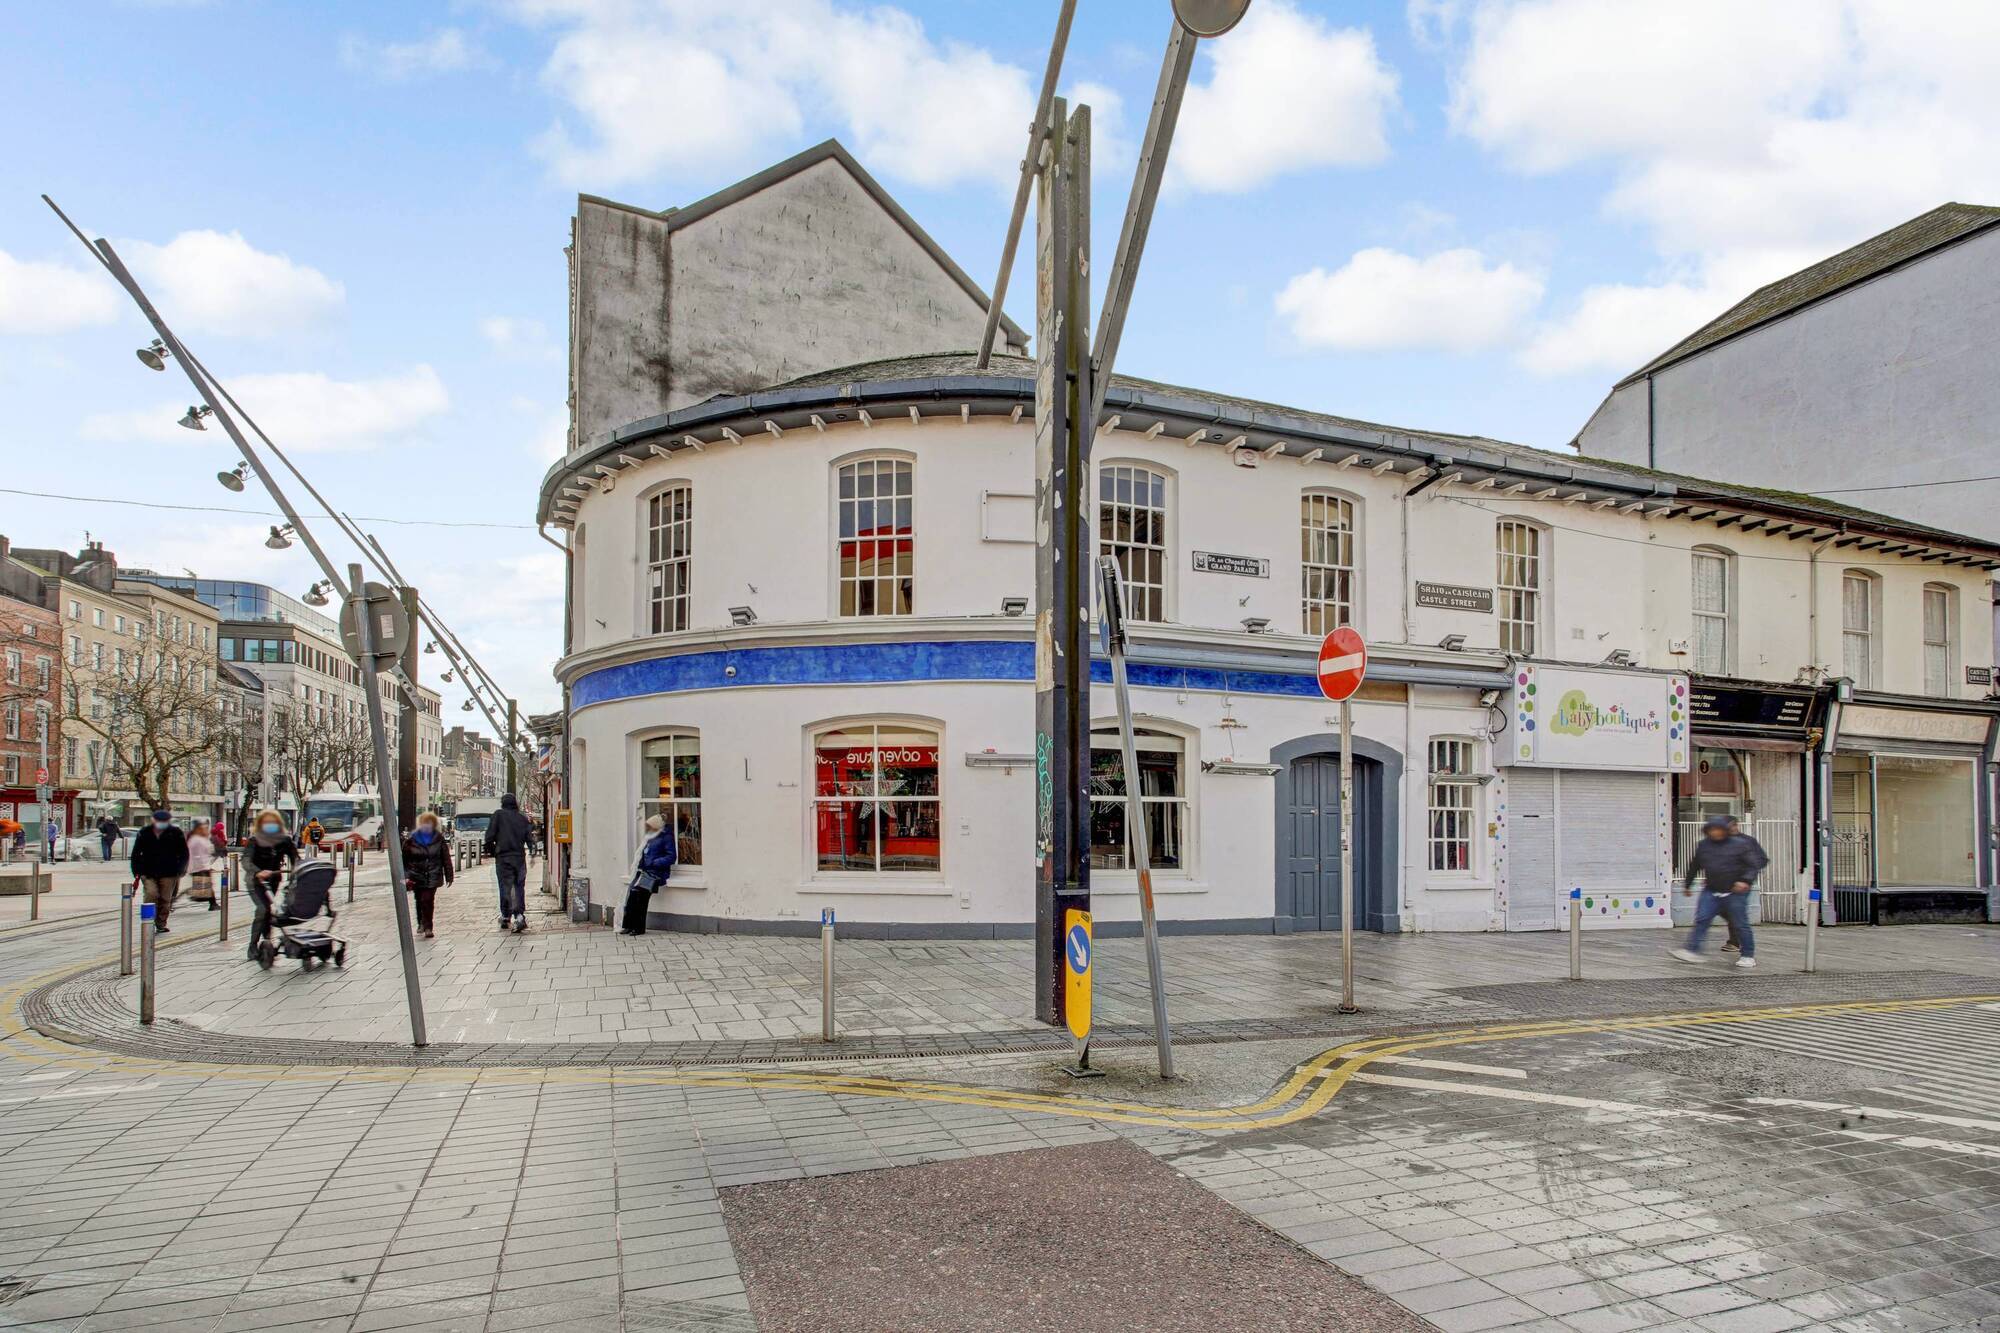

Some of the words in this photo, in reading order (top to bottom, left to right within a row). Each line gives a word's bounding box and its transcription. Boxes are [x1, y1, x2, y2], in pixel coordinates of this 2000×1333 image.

[1211, 563, 1232, 571] GRAND
[1420, 595, 1448, 605] CASTLE
[1450, 598, 1477, 608] STREET
[1579, 701, 1592, 712] the
